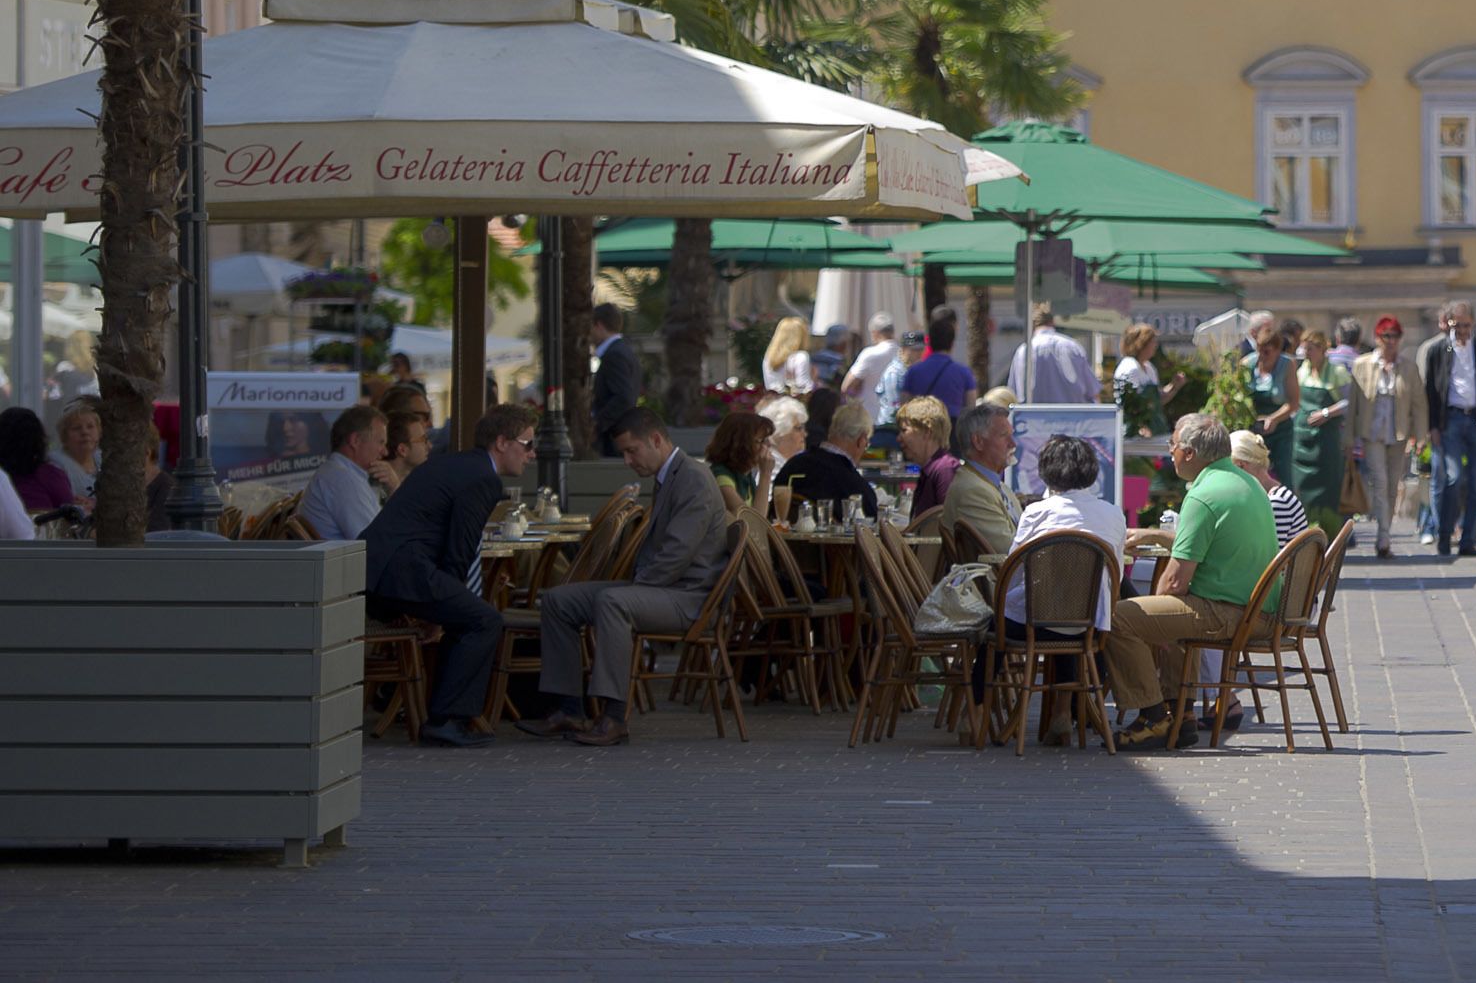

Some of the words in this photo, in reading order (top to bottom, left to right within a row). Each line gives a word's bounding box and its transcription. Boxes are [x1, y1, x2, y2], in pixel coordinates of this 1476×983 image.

[214, 141, 352, 187] Platz
[376, 147, 525, 181] Gelateria
[538, 149, 711, 196] Caffetteria
[718, 152, 851, 186] Italiana
[217, 381, 345, 405] Marionnaud
[227, 465, 263, 480] MEHR
[267, 458, 290, 474] FÜR
[293, 454, 328, 470] MICH
